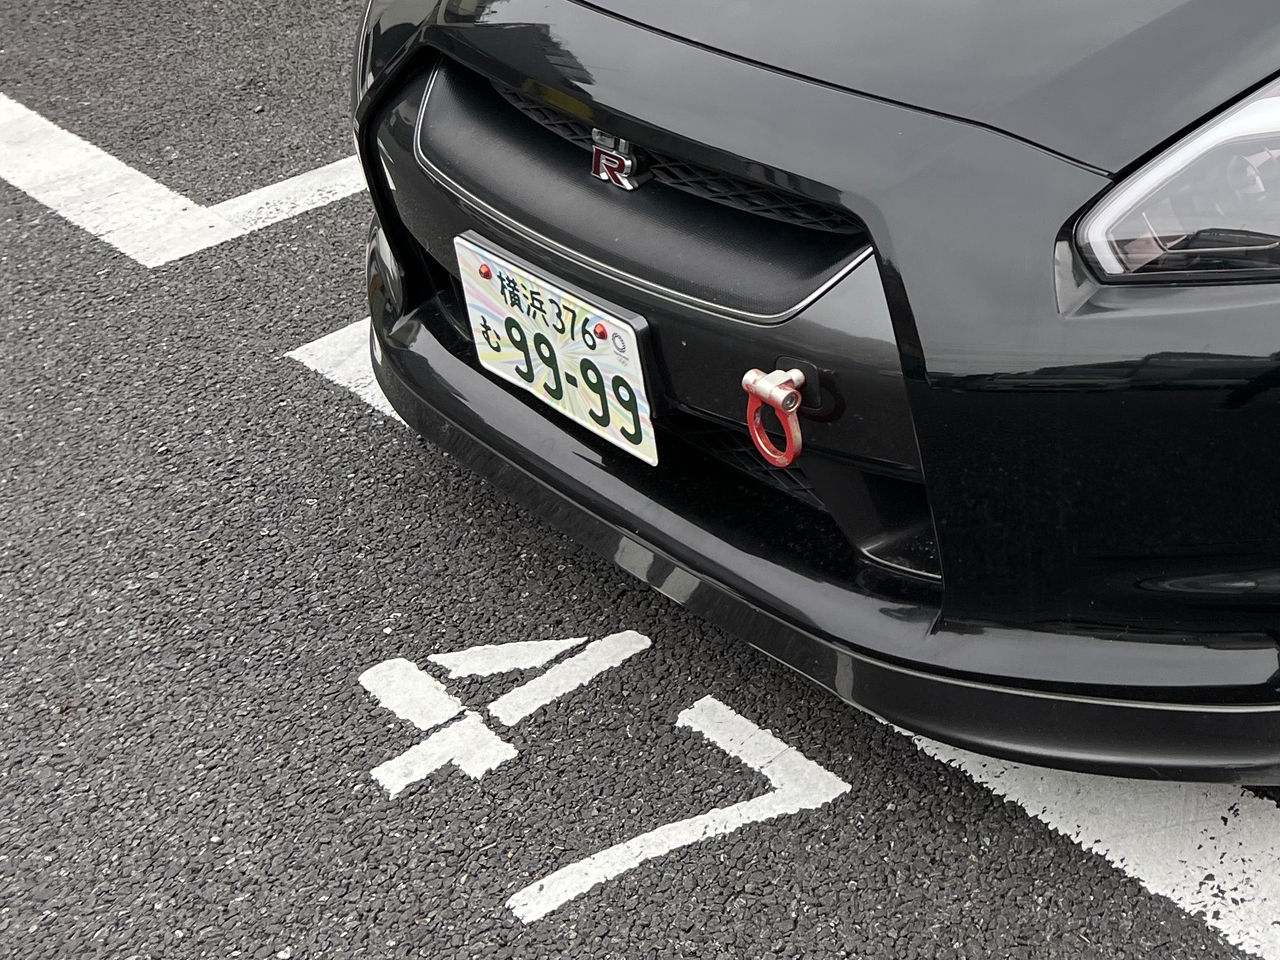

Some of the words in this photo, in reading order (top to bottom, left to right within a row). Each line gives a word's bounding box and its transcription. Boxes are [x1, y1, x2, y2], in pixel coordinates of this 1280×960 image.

[497, 271, 550, 327] 横浜
[549, 298, 597, 350] 376
[505, 317, 642, 445] 99-99
[358, 630, 852, 924] 47
